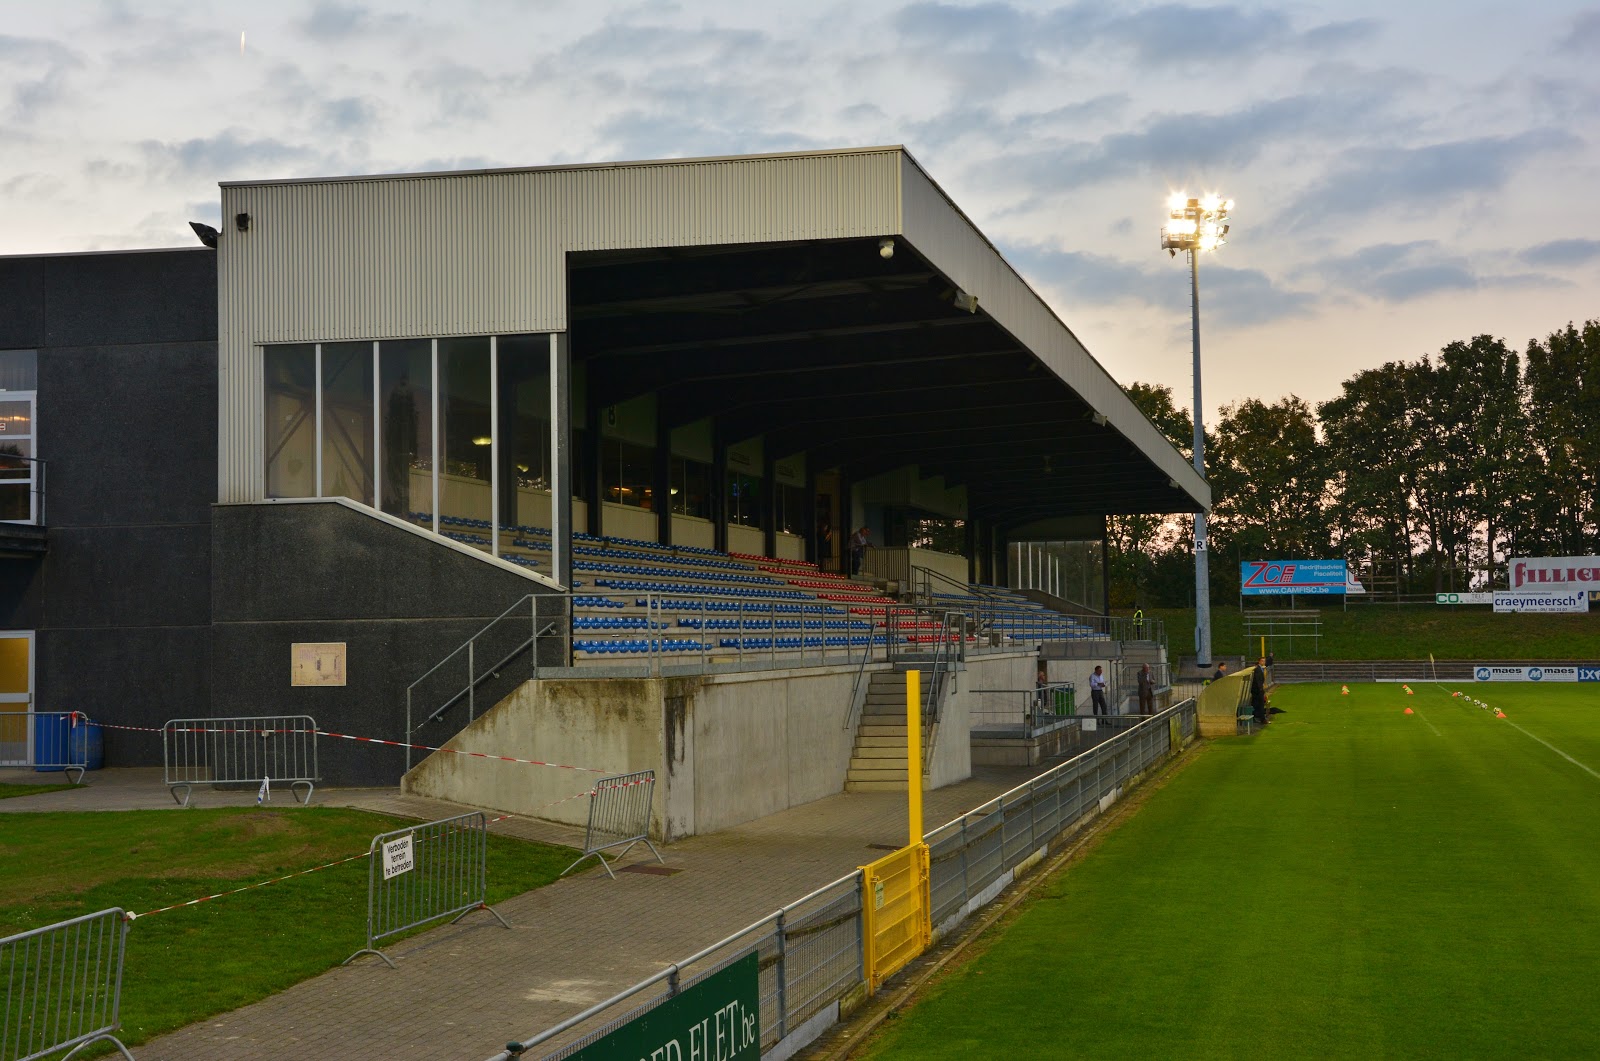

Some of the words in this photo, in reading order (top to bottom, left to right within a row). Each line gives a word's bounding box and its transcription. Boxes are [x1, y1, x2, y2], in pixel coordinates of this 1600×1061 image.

[1196, 541, 1203, 550] R
[1258, 586, 1330, 594] www.CAMFISC.be
[1494, 596, 1576, 608] craeymeersch
[387, 840, 408, 853] Verboden
[391, 852, 405, 863] terrein
[385, 867, 391, 876] te
[391, 860, 411, 872] betreden
